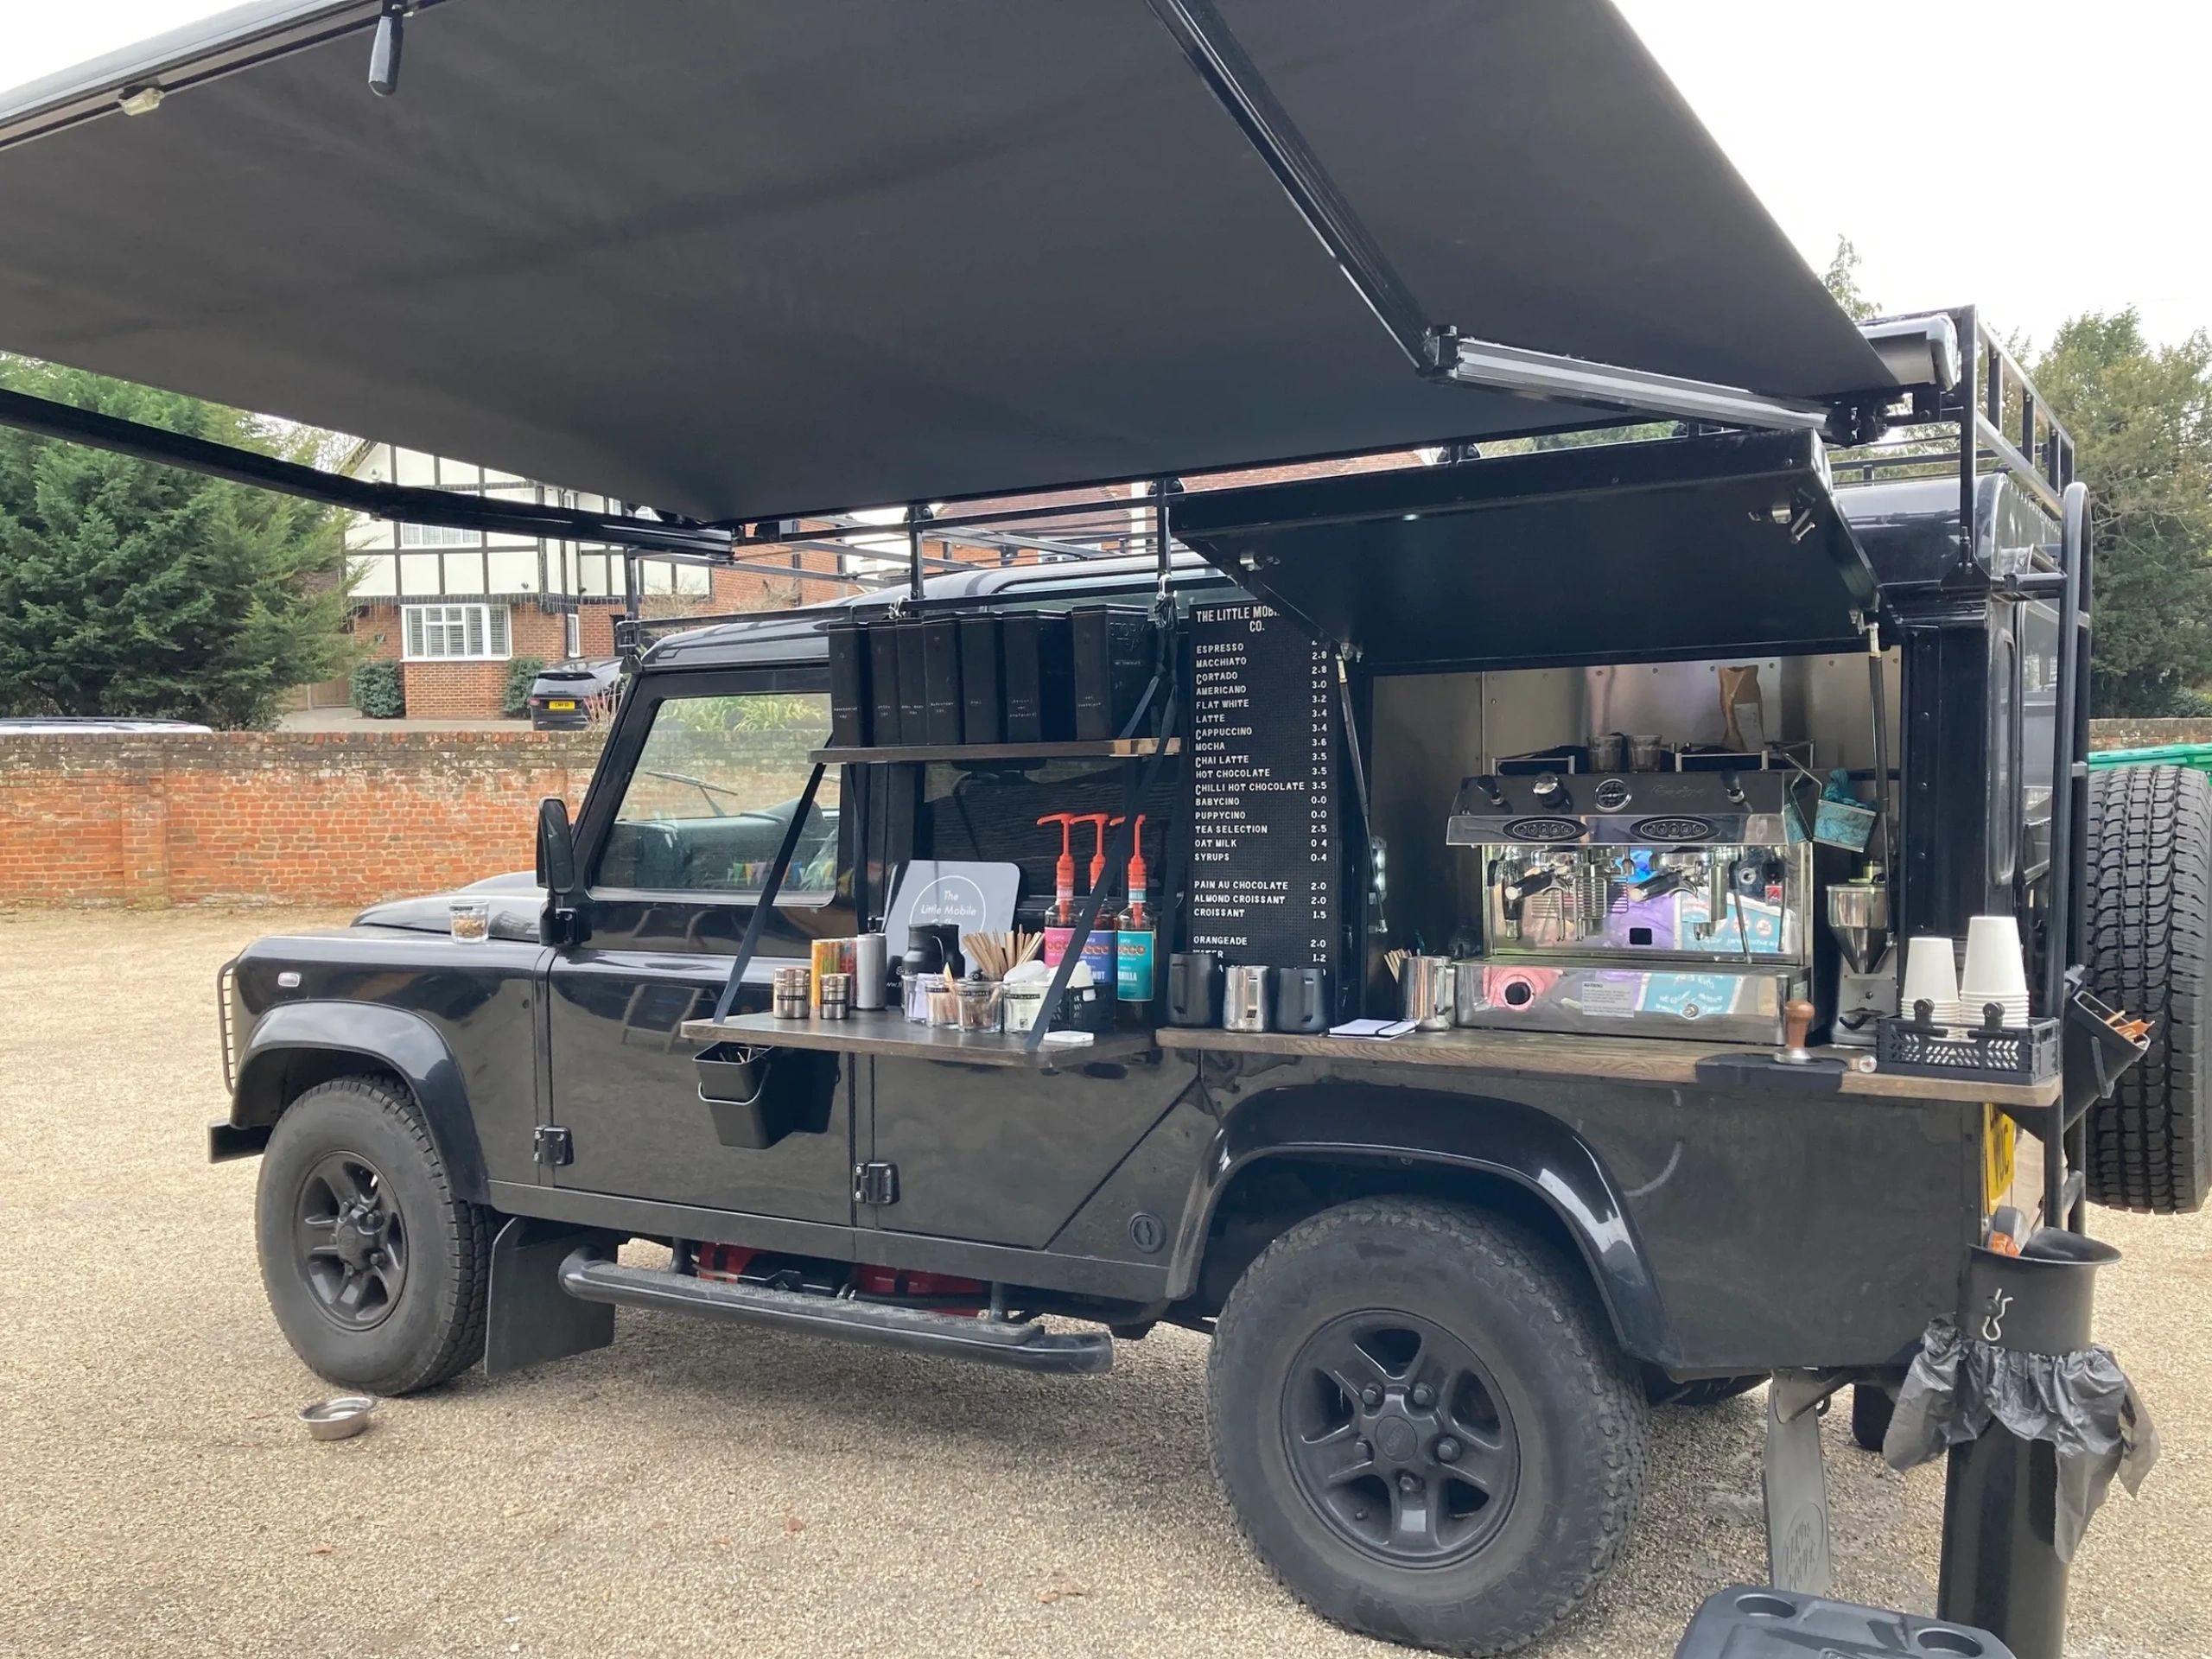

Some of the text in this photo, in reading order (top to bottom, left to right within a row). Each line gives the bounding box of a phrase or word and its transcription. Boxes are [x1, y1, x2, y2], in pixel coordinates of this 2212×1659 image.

[1197, 610, 1214, 622] THE
[1217, 607, 1249, 620] LITTLE
[1249, 620, 1265, 632] CO.
[1197, 643, 1243, 653] ESPRESSO
[1196, 650, 1326, 668] MACCHIATO 2.8
[1196, 664, 1326, 684] CORTADO 2.8
[1196, 679, 1326, 695] AMERICANO 3.0
[1196, 701, 1218, 709] FLAT
[1222, 699, 1249, 708] WHITE
[1196, 709, 1327, 723] LATTE 3.4
[1196, 723, 1327, 740] CAPPUCCINO 3.4
[1196, 738, 1326, 751] MOCHA 3.6
[1196, 752, 1326, 768] CHAI LATTE 3.5
[1196, 766, 1326, 779] HOT CHOCOLATE 3.5
[1196, 781, 1327, 795] CHILLI HOT CHOCOLATE 3.5
[1195, 797, 1239, 805] BABYCINO
[1195, 810, 1326, 820] PUPPYCINO 0.0
[1216, 824, 1268, 833] SELECTION
[1311, 824, 1326, 833] 2.5
[1195, 853, 1327, 861] SYRUPS 0.4
[1194, 880, 1215, 889] PAIN
[1218, 880, 1230, 889] AU
[1233, 880, 1288, 890] CHOCOLATE
[944, 889, 959, 901] The
[1194, 894, 1230, 903] ALMOND
[1233, 894, 1285, 904] CROISSANT
[921, 904, 976, 916] Little Mobile
[1194, 908, 1245, 917] CROISSANT
[1193, 936, 1247, 945] ORANGEADE
[1313, 953, 1326, 962] 1.2
